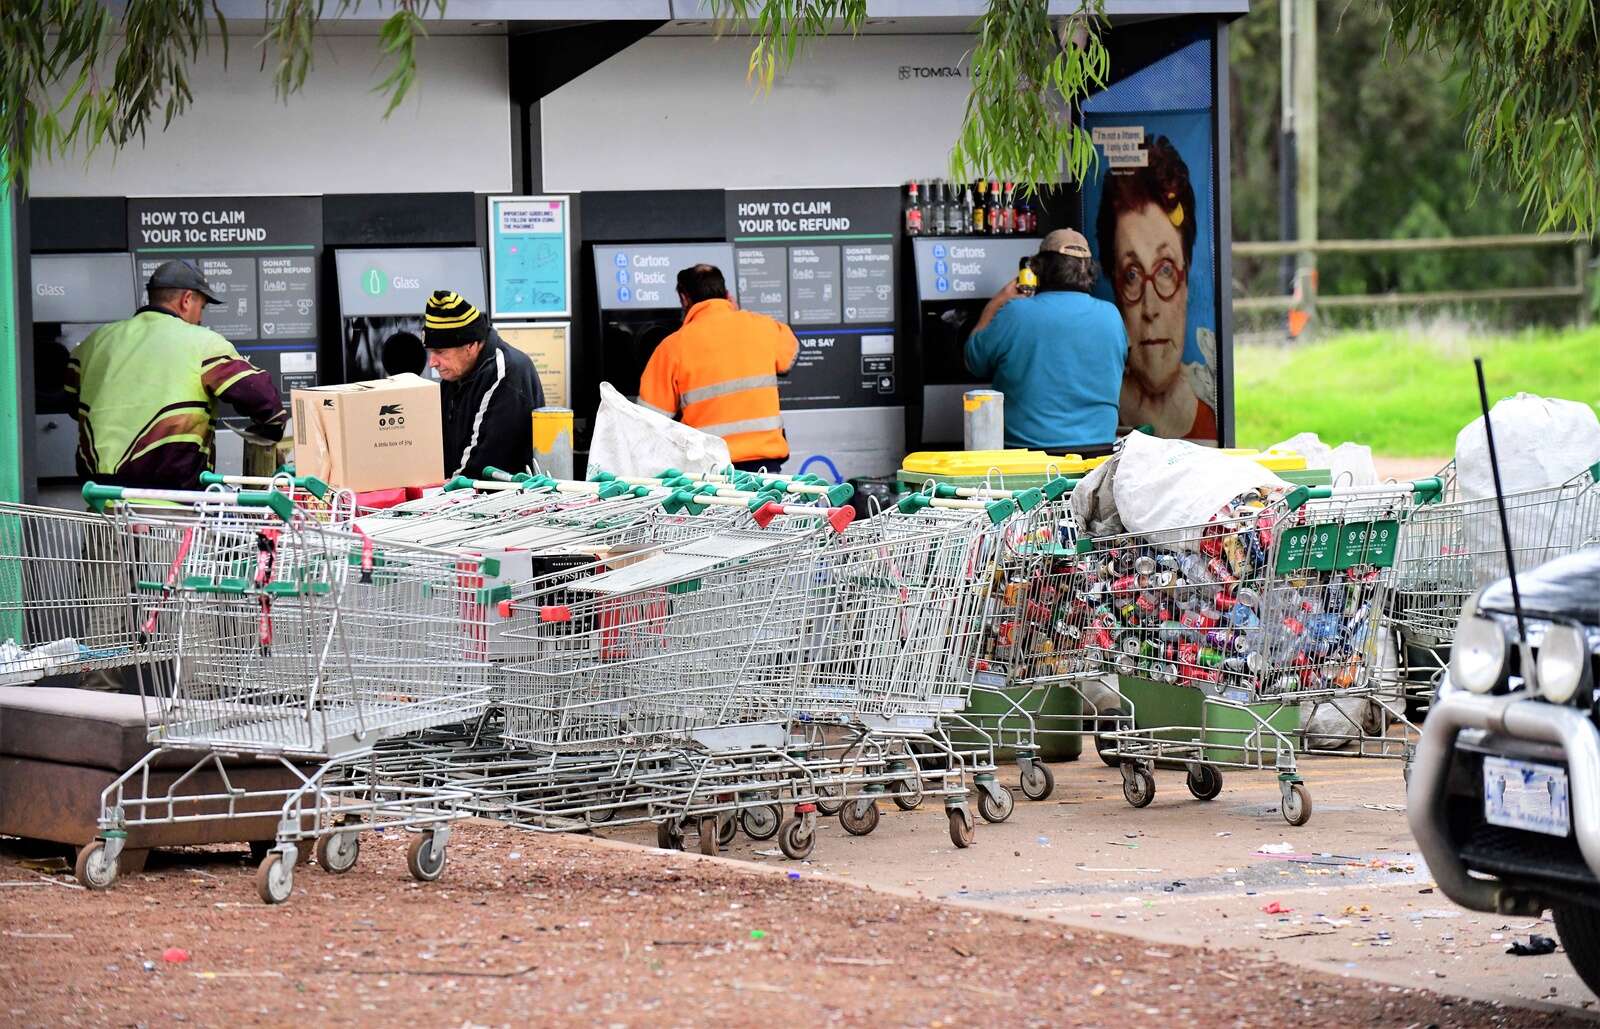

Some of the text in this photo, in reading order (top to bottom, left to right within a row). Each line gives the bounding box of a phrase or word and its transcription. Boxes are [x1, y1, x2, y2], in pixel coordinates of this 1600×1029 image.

[912, 67, 962, 78] TOMRA
[738, 201, 831, 216] HOW TO CLAIM
[141, 211, 245, 225] HOW TO CLAIM
[738, 218, 850, 232] YOUR 10c REFUND
[141, 228, 267, 243] YOUR 10c REFUND
[950, 246, 986, 258] Cartons
[632, 254, 670, 267] Cartons
[952, 262, 982, 275] Plastic
[392, 276, 421, 289] Glass
[634, 271, 666, 284] Plastic
[36, 283, 65, 296] Glass
[953, 279, 976, 291] Cans
[636, 288, 660, 301] Cans
[817, 338, 835, 347] SAY
